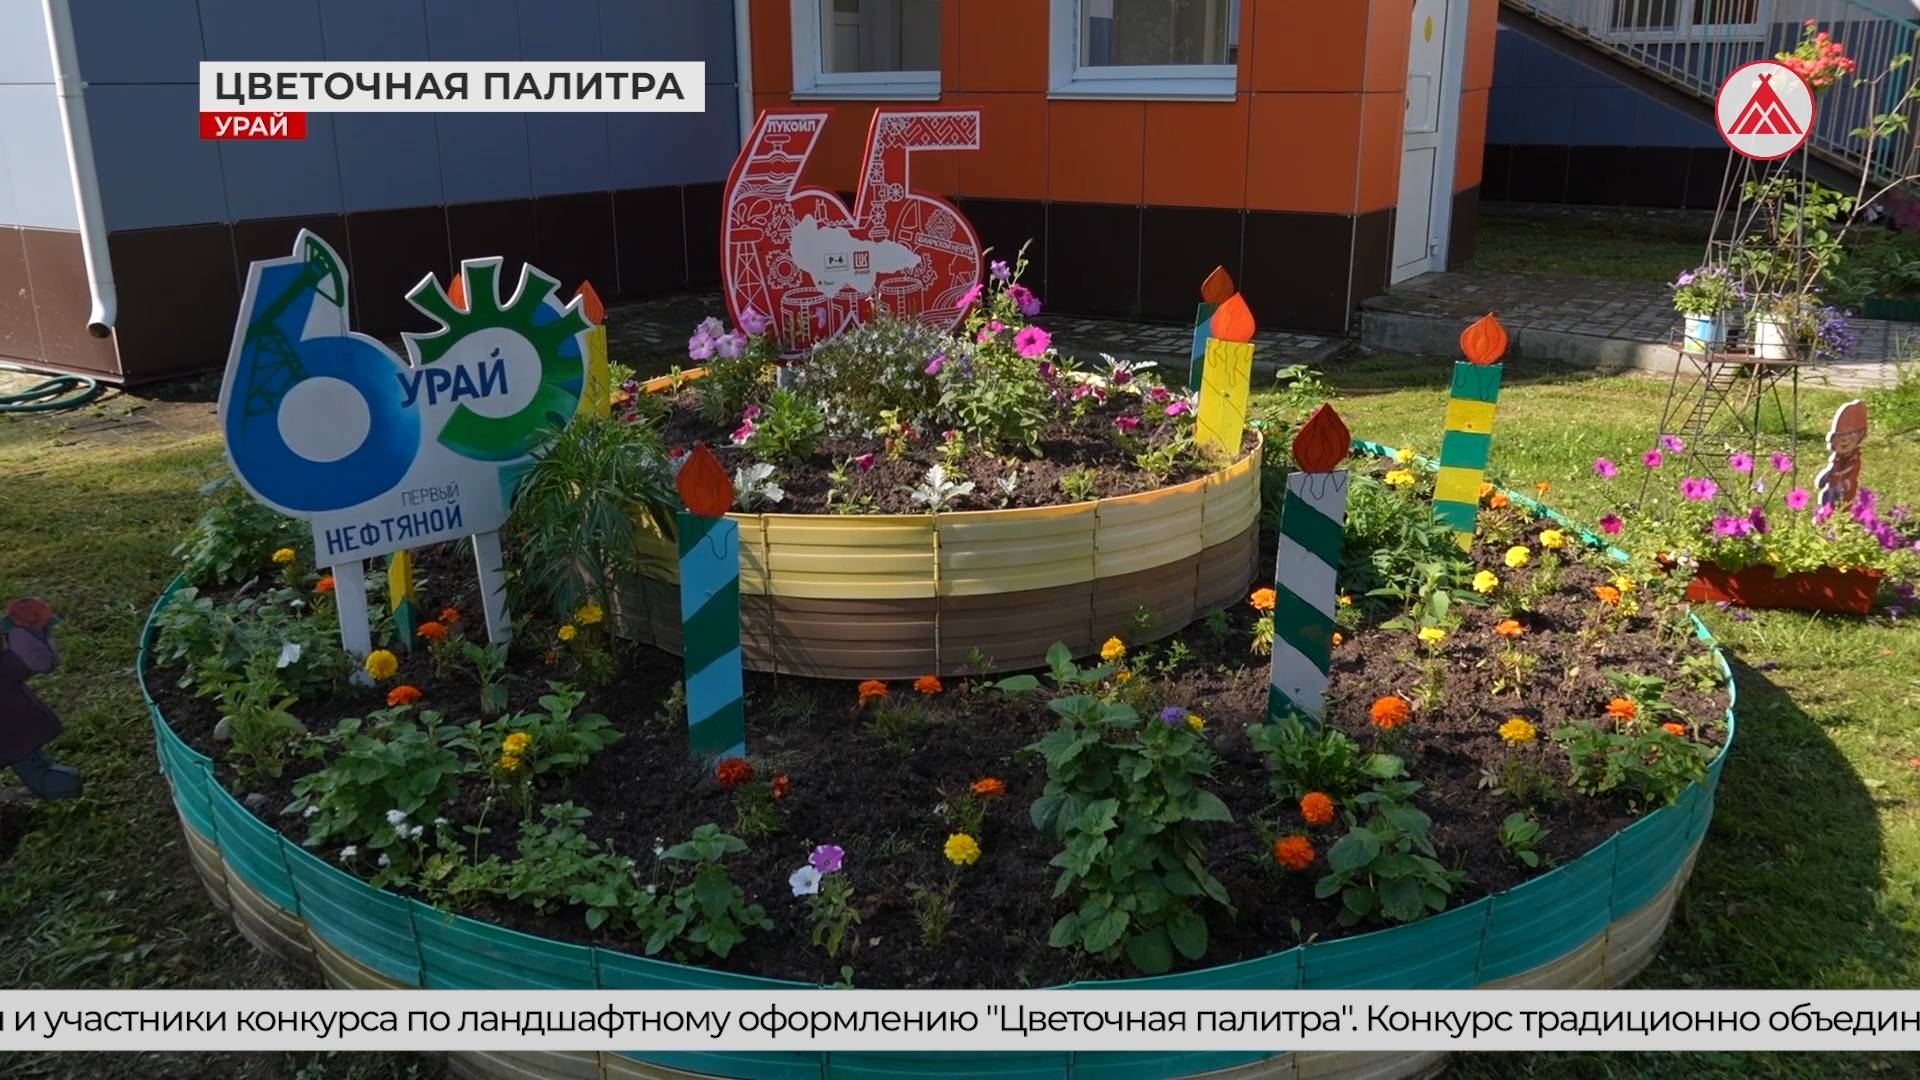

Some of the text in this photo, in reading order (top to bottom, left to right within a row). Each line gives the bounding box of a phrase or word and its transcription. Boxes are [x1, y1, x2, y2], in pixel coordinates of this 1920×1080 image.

[396, 347, 509, 408] УРАЙ
[401, 481, 460, 507] ПЕРВЫЙ
[325, 499, 464, 555] НЕФТЯНОЙ
